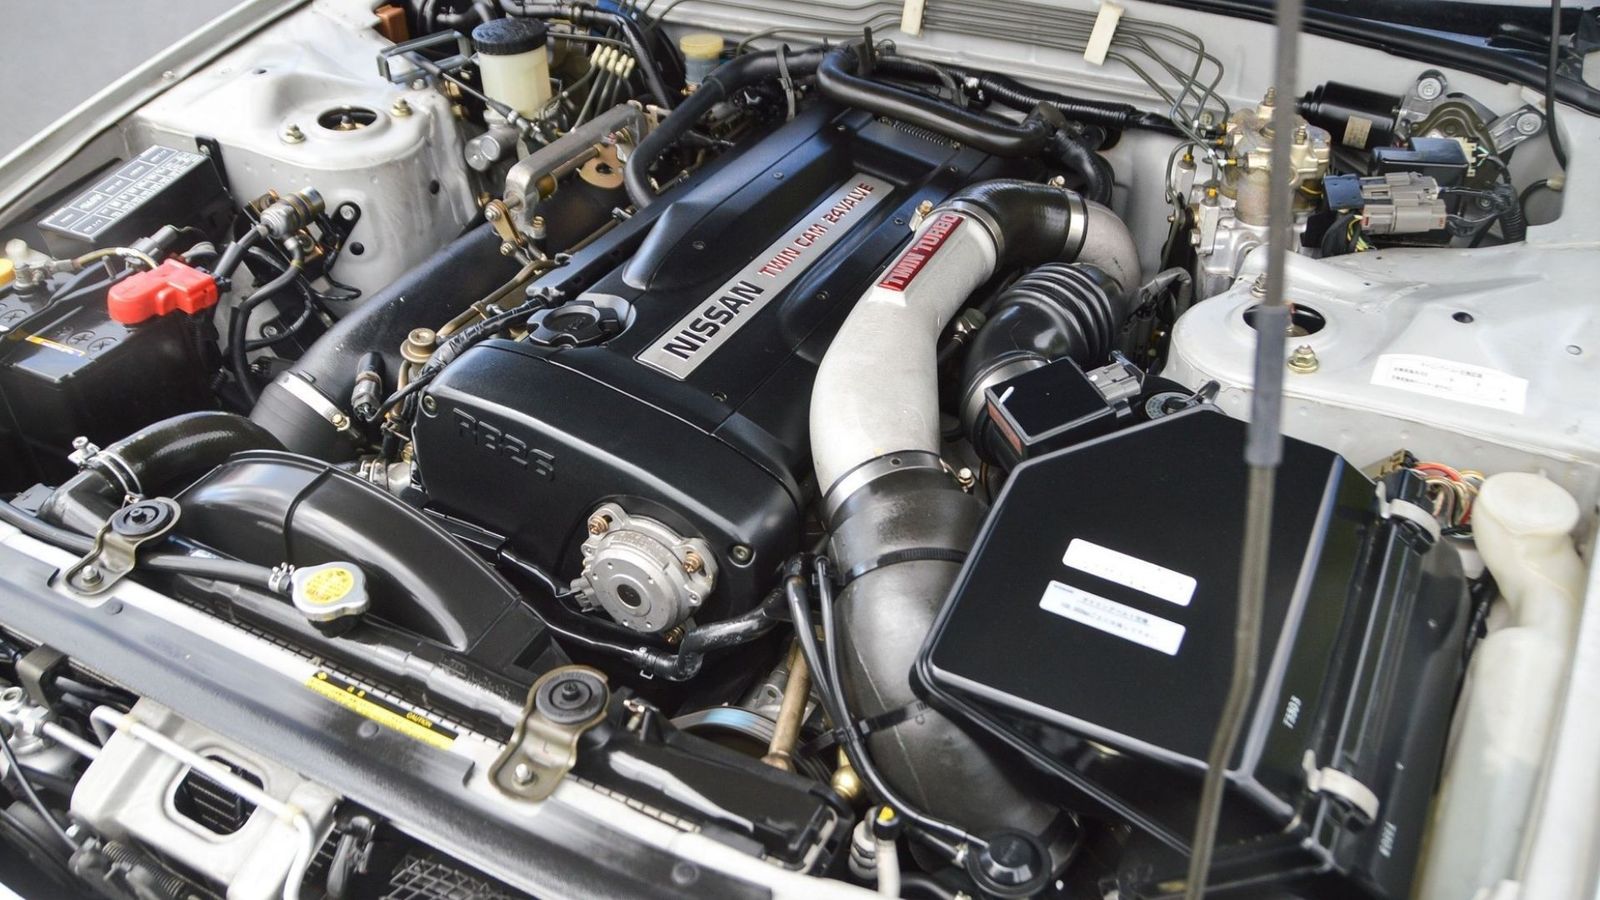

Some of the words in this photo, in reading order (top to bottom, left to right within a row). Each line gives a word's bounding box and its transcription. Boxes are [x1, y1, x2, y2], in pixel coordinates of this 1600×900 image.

[662, 280, 764, 360] NISSAN
[758, 246, 801, 277] TWIN
[794, 223, 828, 248] CAM
[821, 183, 874, 225] 24VALVE
[881, 251, 926, 286] TWIN
[912, 213, 959, 252] TURBO
[452, 407, 556, 481] RB26
[406, 711, 433, 729] CAUTION
